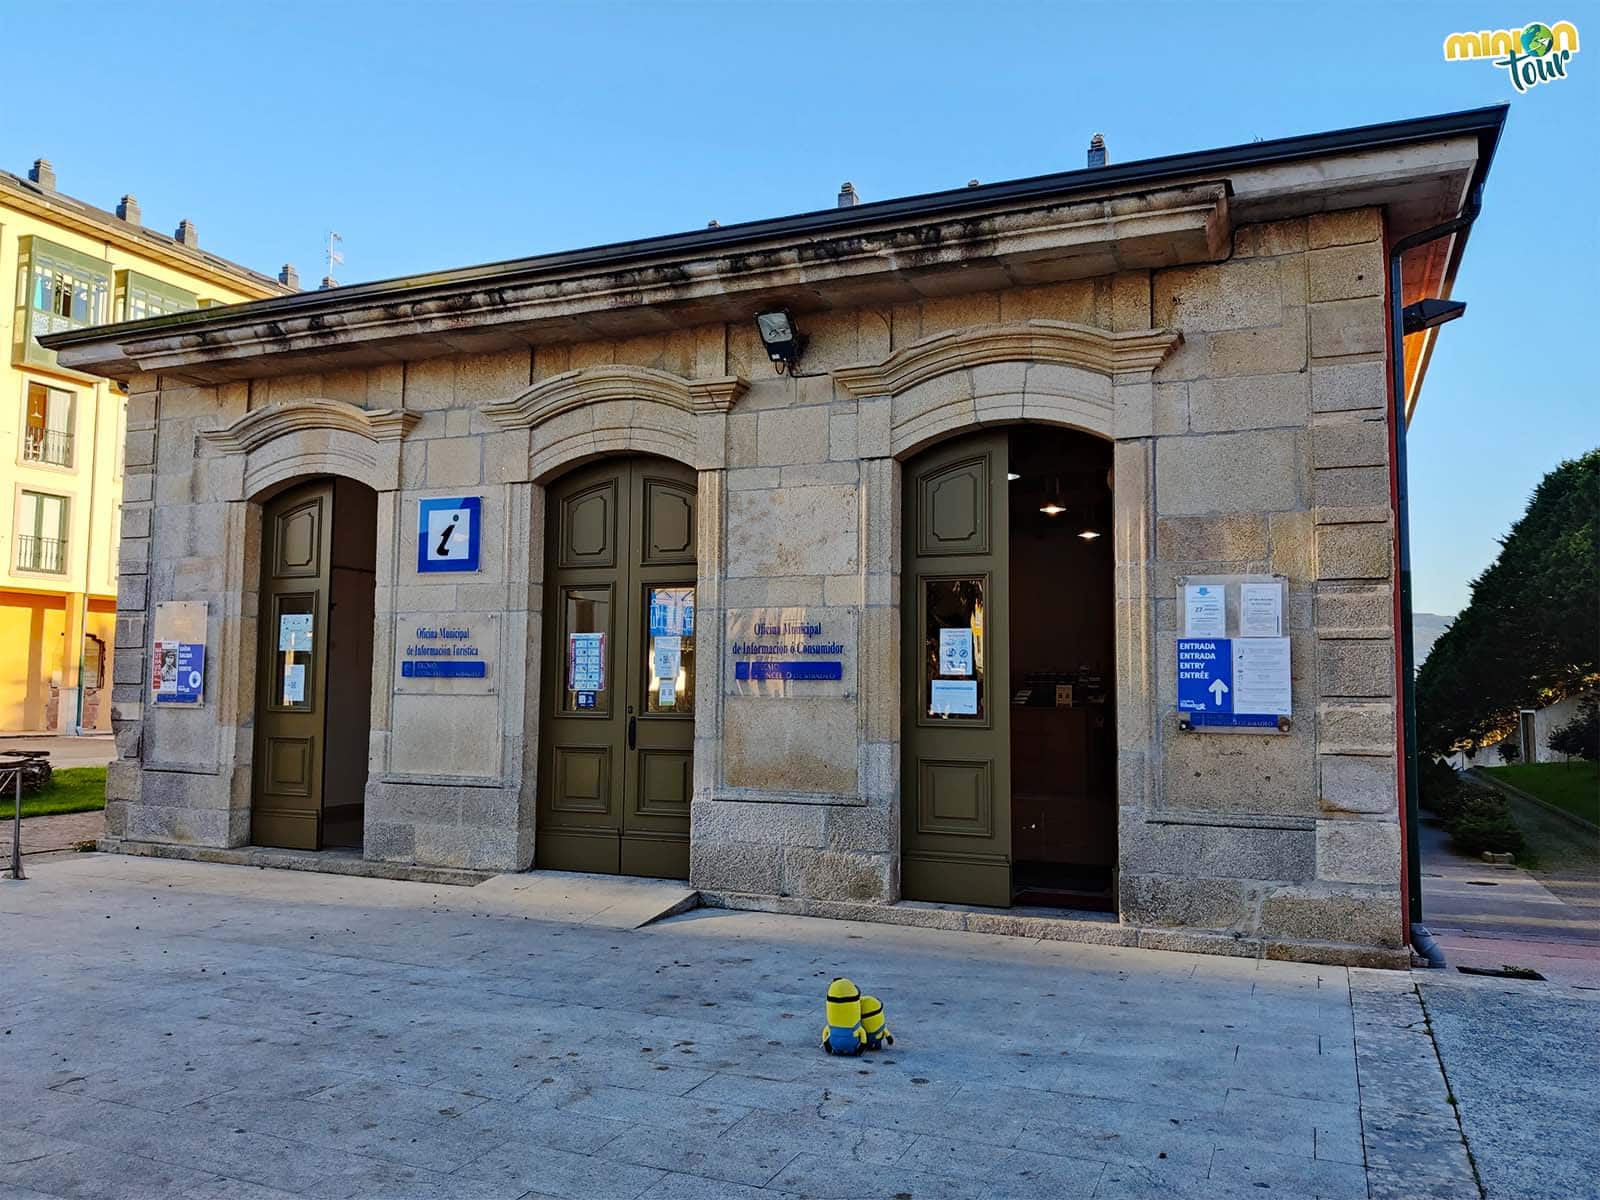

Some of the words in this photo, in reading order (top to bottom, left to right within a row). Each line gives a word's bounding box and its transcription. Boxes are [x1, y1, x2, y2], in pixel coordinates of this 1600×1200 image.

[416, 627, 437, 640] Oficina
[440, 627, 470, 641] Municipal
[754, 622, 780, 638] Oficina
[783, 622, 822, 638] Municipal
[406, 645, 414, 656] de
[415, 644, 451, 656] Información
[732, 642, 741, 654] de
[743, 641, 787, 656] Información
[797, 641, 844, 654] Consumidor
[1179, 642, 1216, 650] ENTRADA
[1179, 652, 1216, 660] ENTRADA
[1179, 662, 1205, 670] ENTRY
[1179, 671, 1210, 680] ENTRÉE
